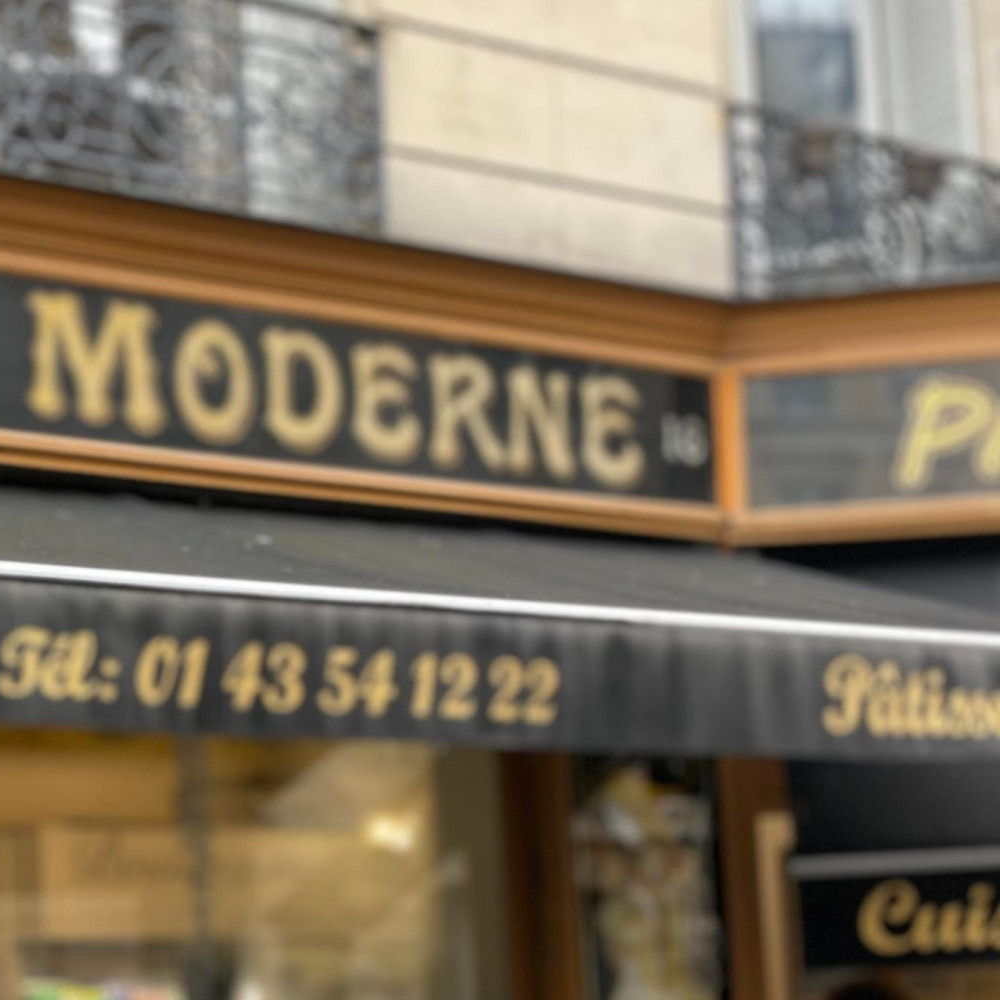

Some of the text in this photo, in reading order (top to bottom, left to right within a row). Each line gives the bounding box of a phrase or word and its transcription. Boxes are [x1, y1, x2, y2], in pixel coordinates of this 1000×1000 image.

[27, 290, 645, 488] MODERNE
[895, 374, 1000, 487] P
[135, 635, 210, 710] 01
[220, 640, 308, 716] 43
[316, 645, 398, 717] 54
[409, 650, 479, 721] 12
[487, 654, 561, 726] 22
